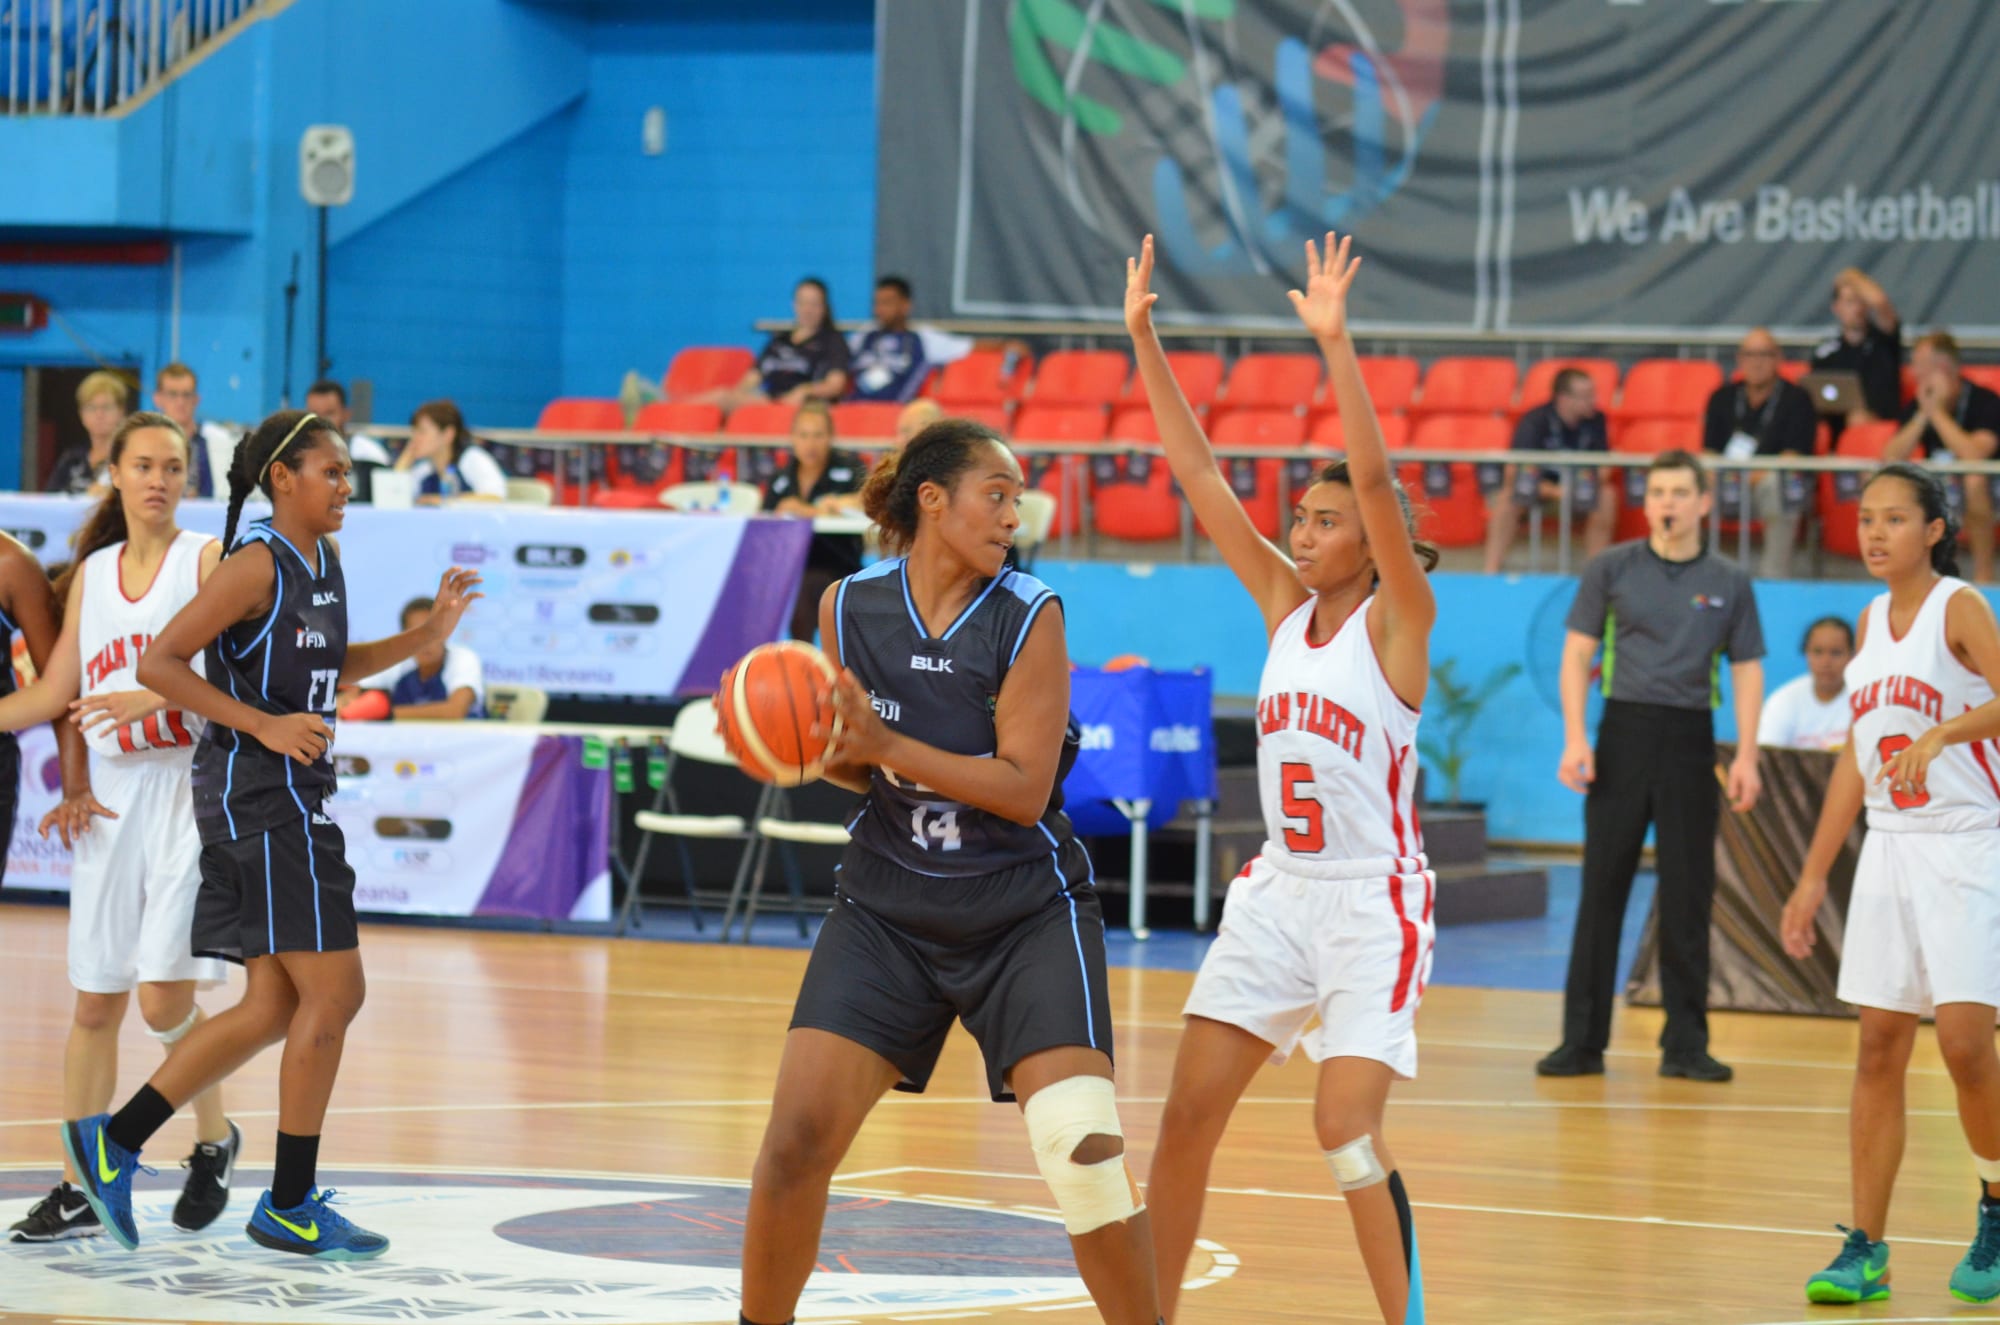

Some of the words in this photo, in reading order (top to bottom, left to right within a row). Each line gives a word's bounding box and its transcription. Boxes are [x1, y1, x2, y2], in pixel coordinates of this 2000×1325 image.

[1568, 183, 1648, 246] We
[1659, 184, 1746, 246] Are
[1754, 181, 2000, 244] Basketball
[313, 592, 338, 606] BLK
[911, 655, 954, 674] BLK
[1296, 691, 1366, 763] TAHITI
[911, 804, 962, 851] 14
[1281, 762, 1325, 853] 5
